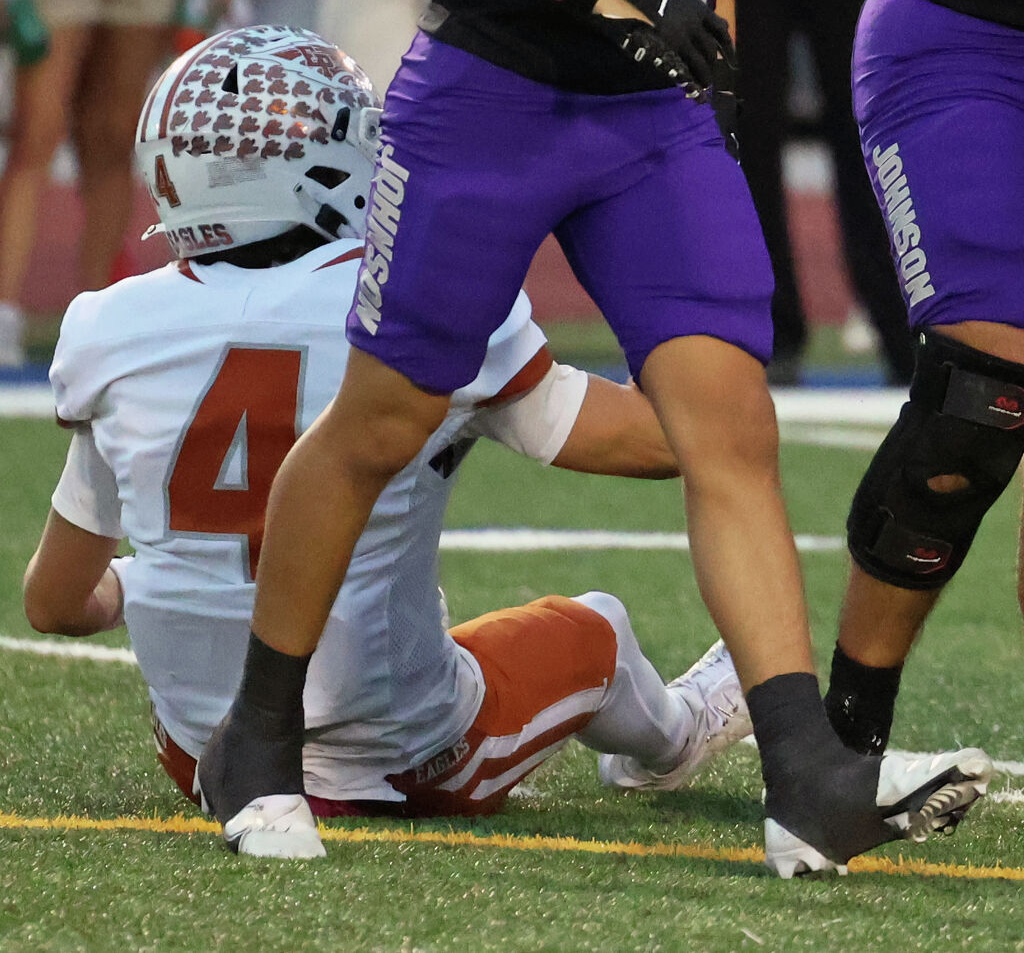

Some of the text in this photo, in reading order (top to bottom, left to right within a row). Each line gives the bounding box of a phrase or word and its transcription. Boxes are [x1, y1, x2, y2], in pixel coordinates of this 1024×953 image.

[155, 154, 181, 208] 4
[354, 144, 410, 336] JOHNSON
[873, 142, 936, 308] JOHNSON
[163, 342, 309, 584] 4
